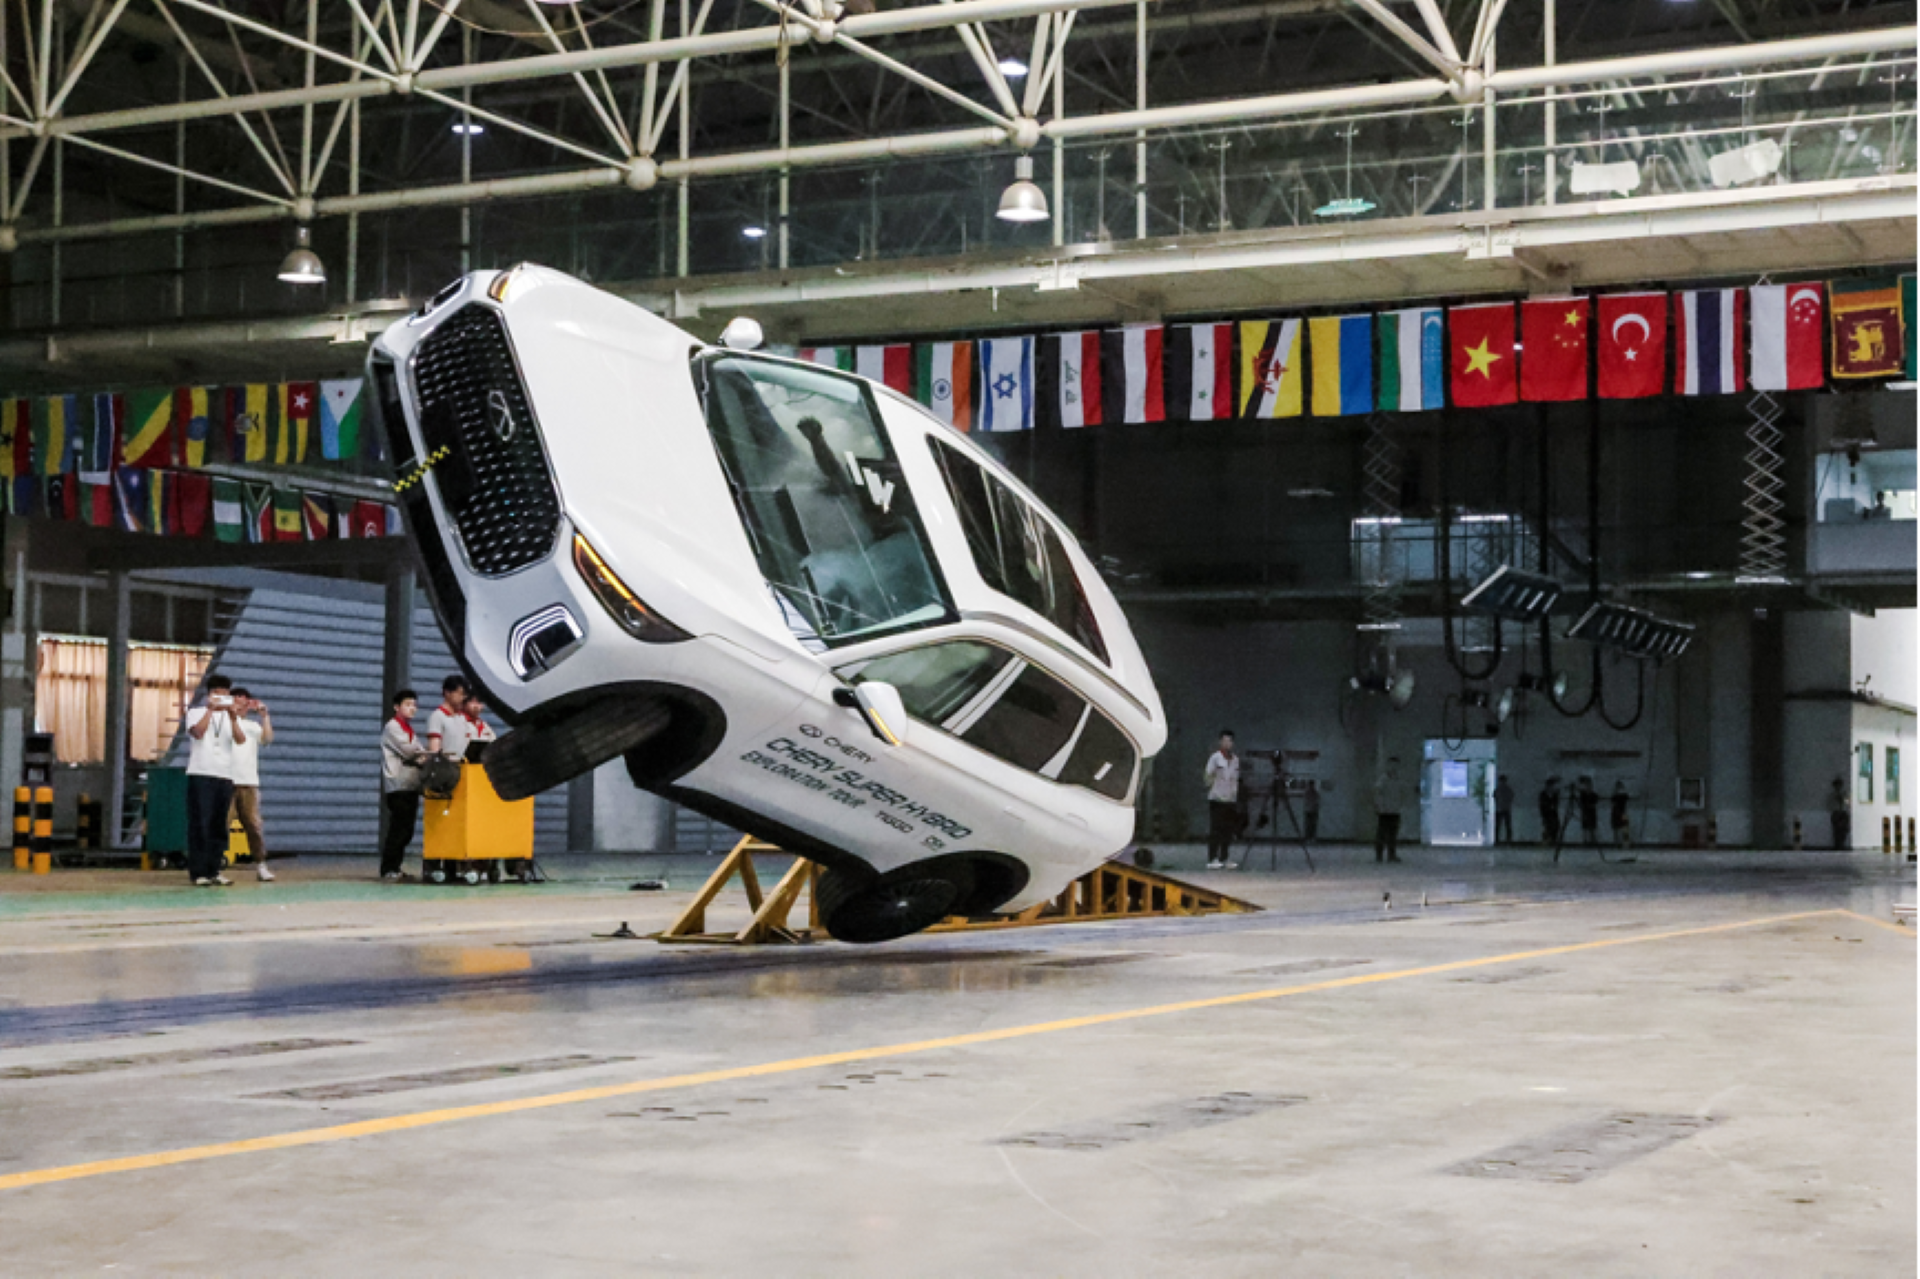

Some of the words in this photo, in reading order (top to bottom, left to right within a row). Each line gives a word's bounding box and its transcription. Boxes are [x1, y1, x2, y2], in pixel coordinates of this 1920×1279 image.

[823, 735, 876, 764] CHERY
[766, 737, 844, 773] CHERY
[832, 770, 908, 806] SUPER
[897, 801, 973, 839] HYBRID
